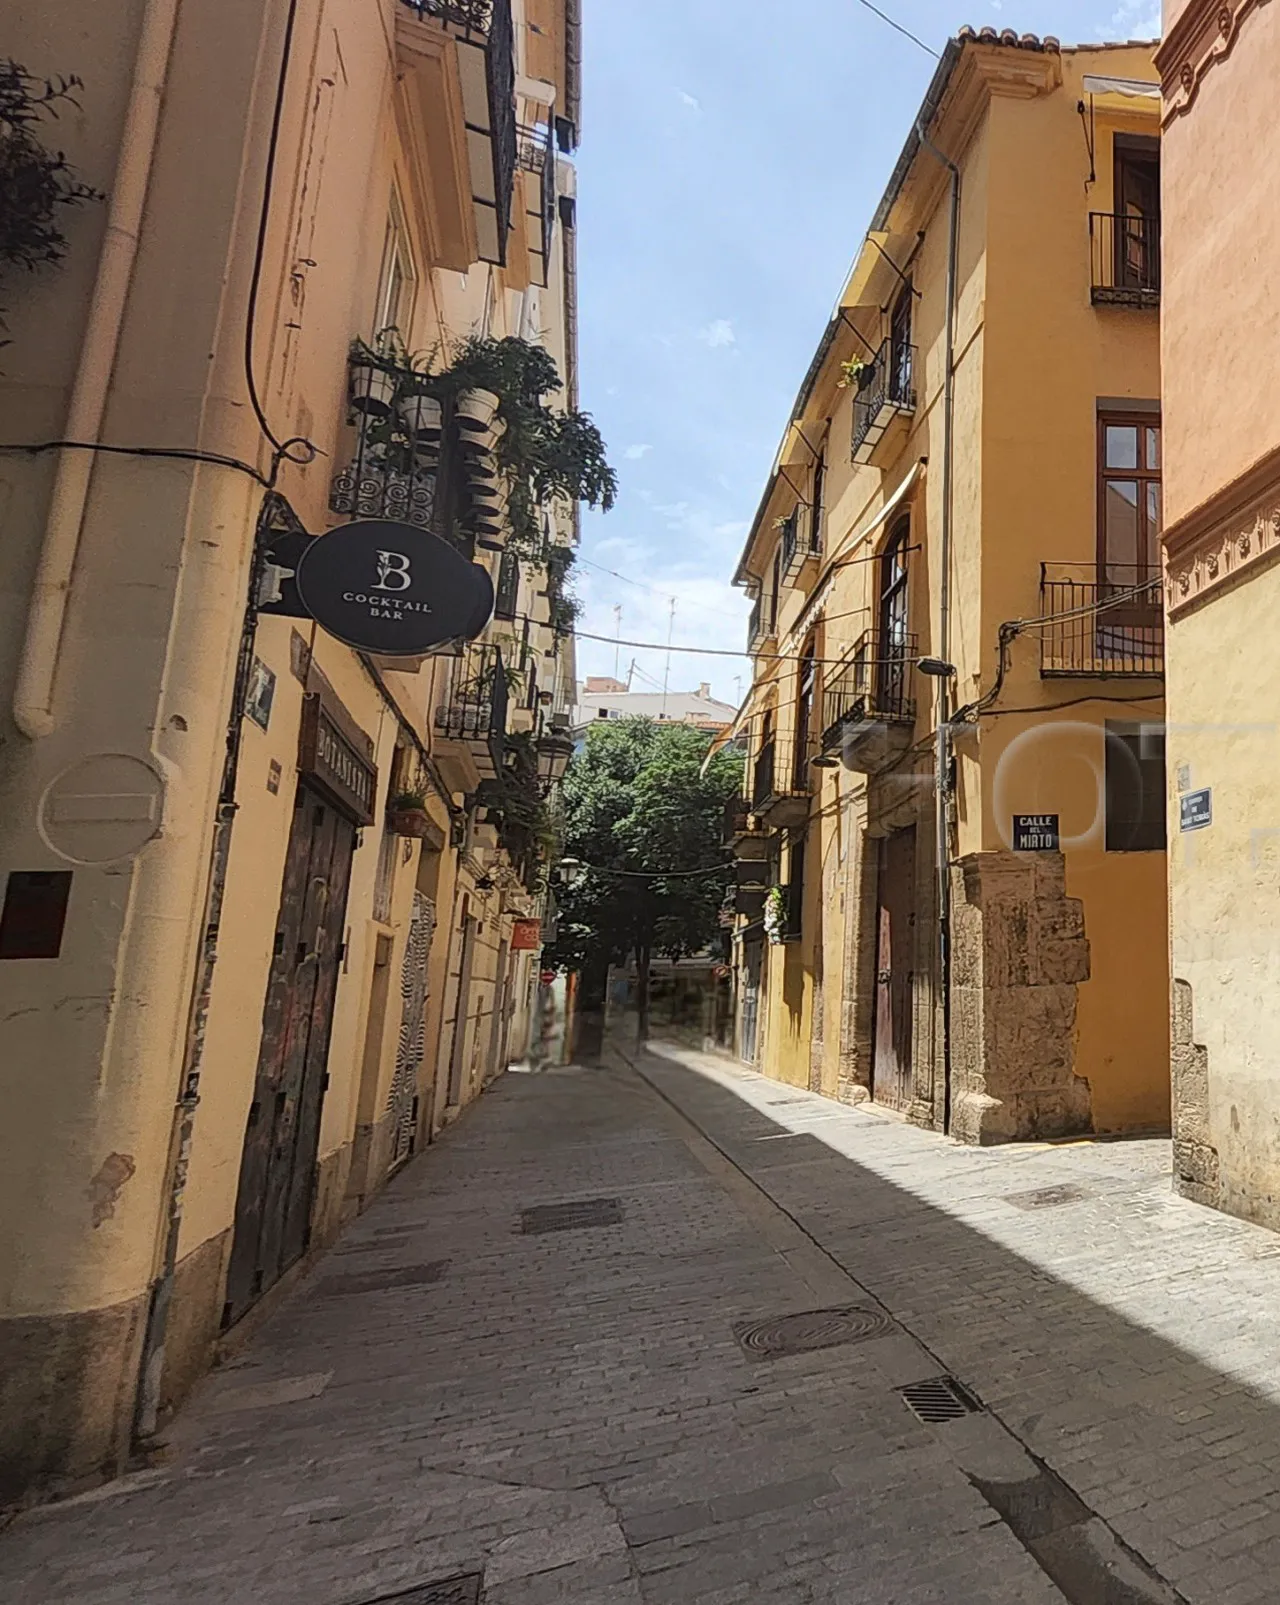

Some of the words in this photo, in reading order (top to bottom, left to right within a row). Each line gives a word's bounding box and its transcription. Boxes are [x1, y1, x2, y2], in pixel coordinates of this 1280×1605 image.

[370, 549, 411, 591] B
[342, 592, 432, 613] COCKTAIL
[370, 607, 403, 620] BAR
[1019, 816, 1052, 826] CALLE
[1029, 826, 1041, 834] DEL
[1020, 834, 1052, 848] MIRTO
